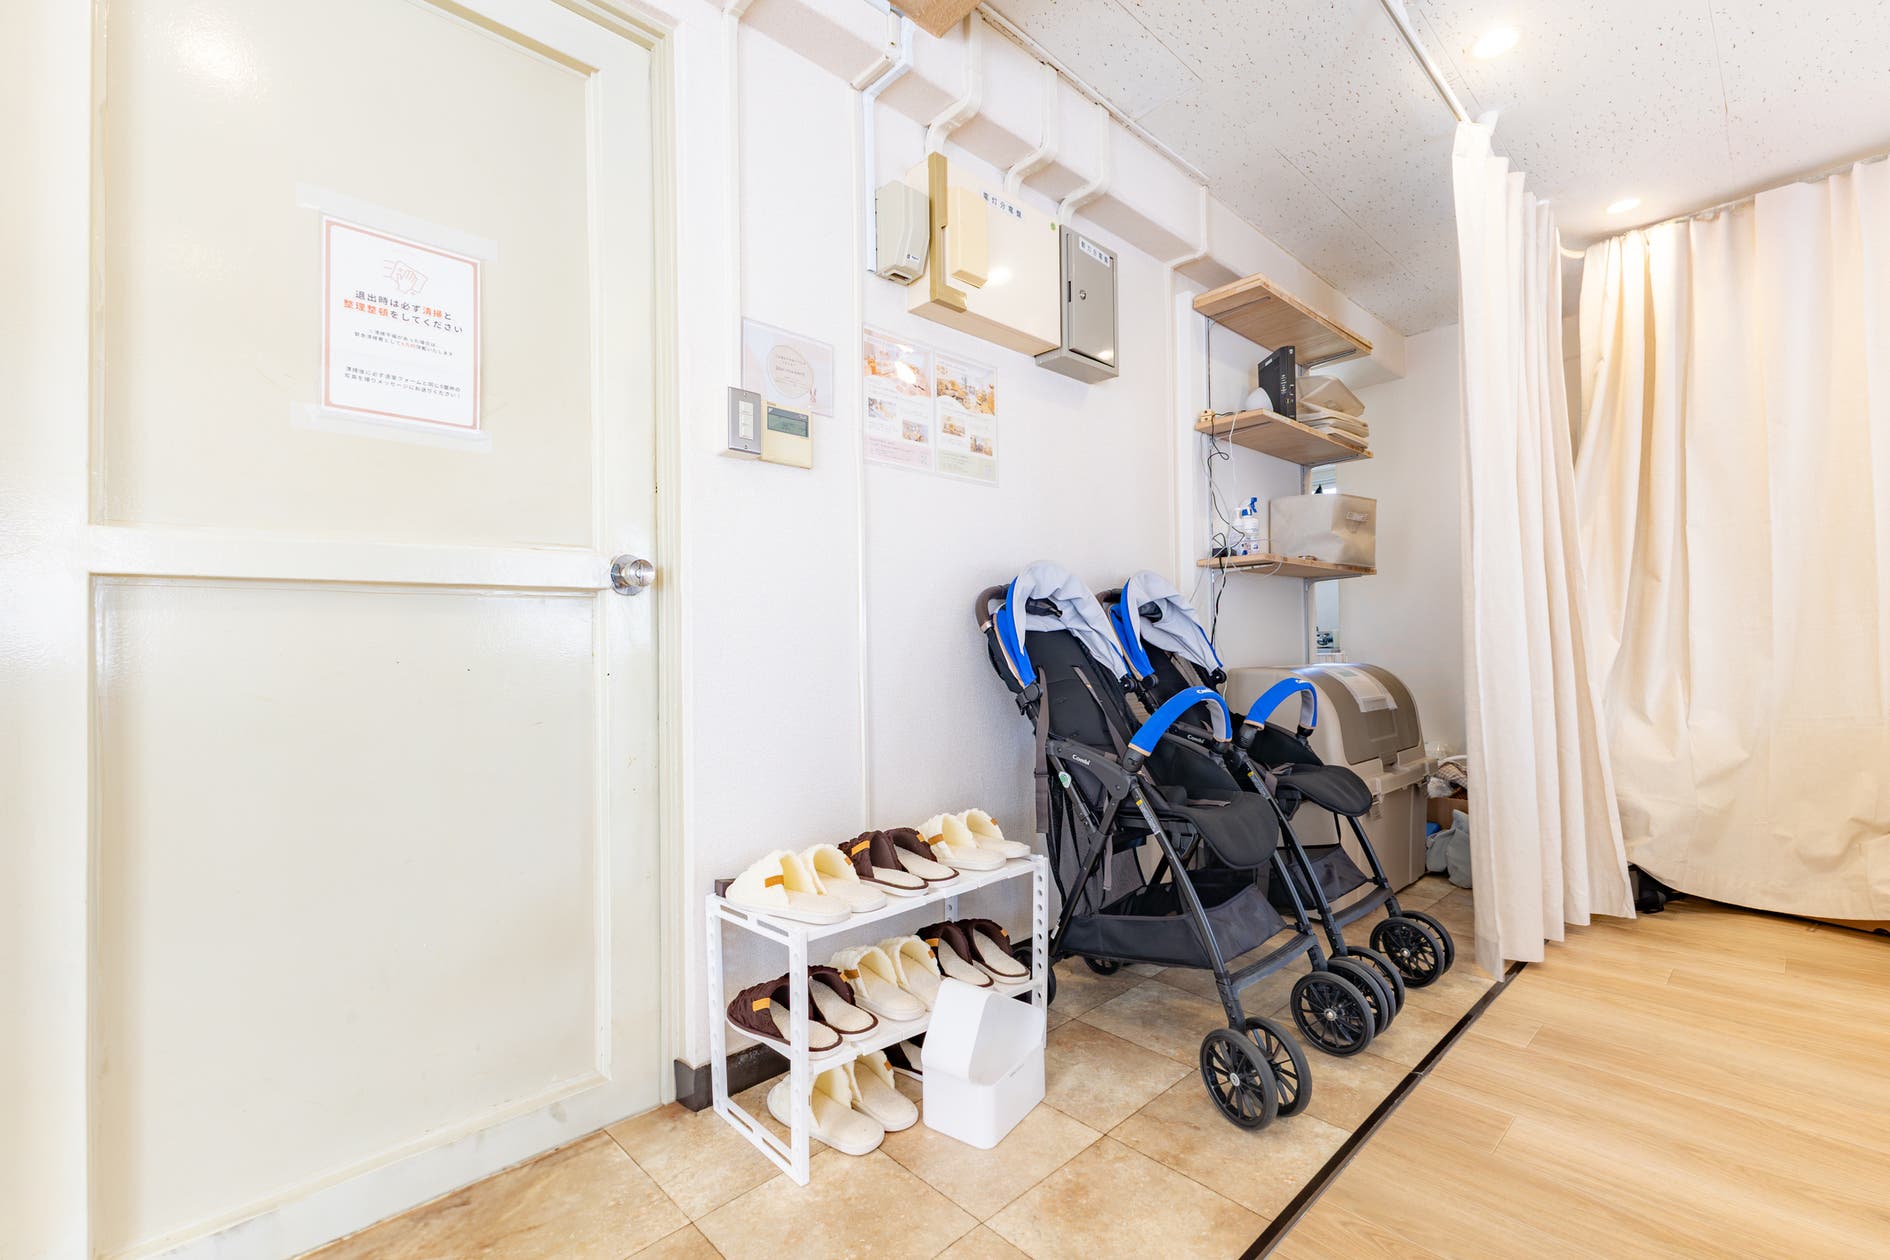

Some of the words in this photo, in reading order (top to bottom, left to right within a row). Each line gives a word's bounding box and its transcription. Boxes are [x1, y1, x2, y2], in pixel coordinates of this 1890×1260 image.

[343, 298, 463, 333] 整理整頓をしてください
[355, 289, 452, 321] 退出時は必ず清掃と
